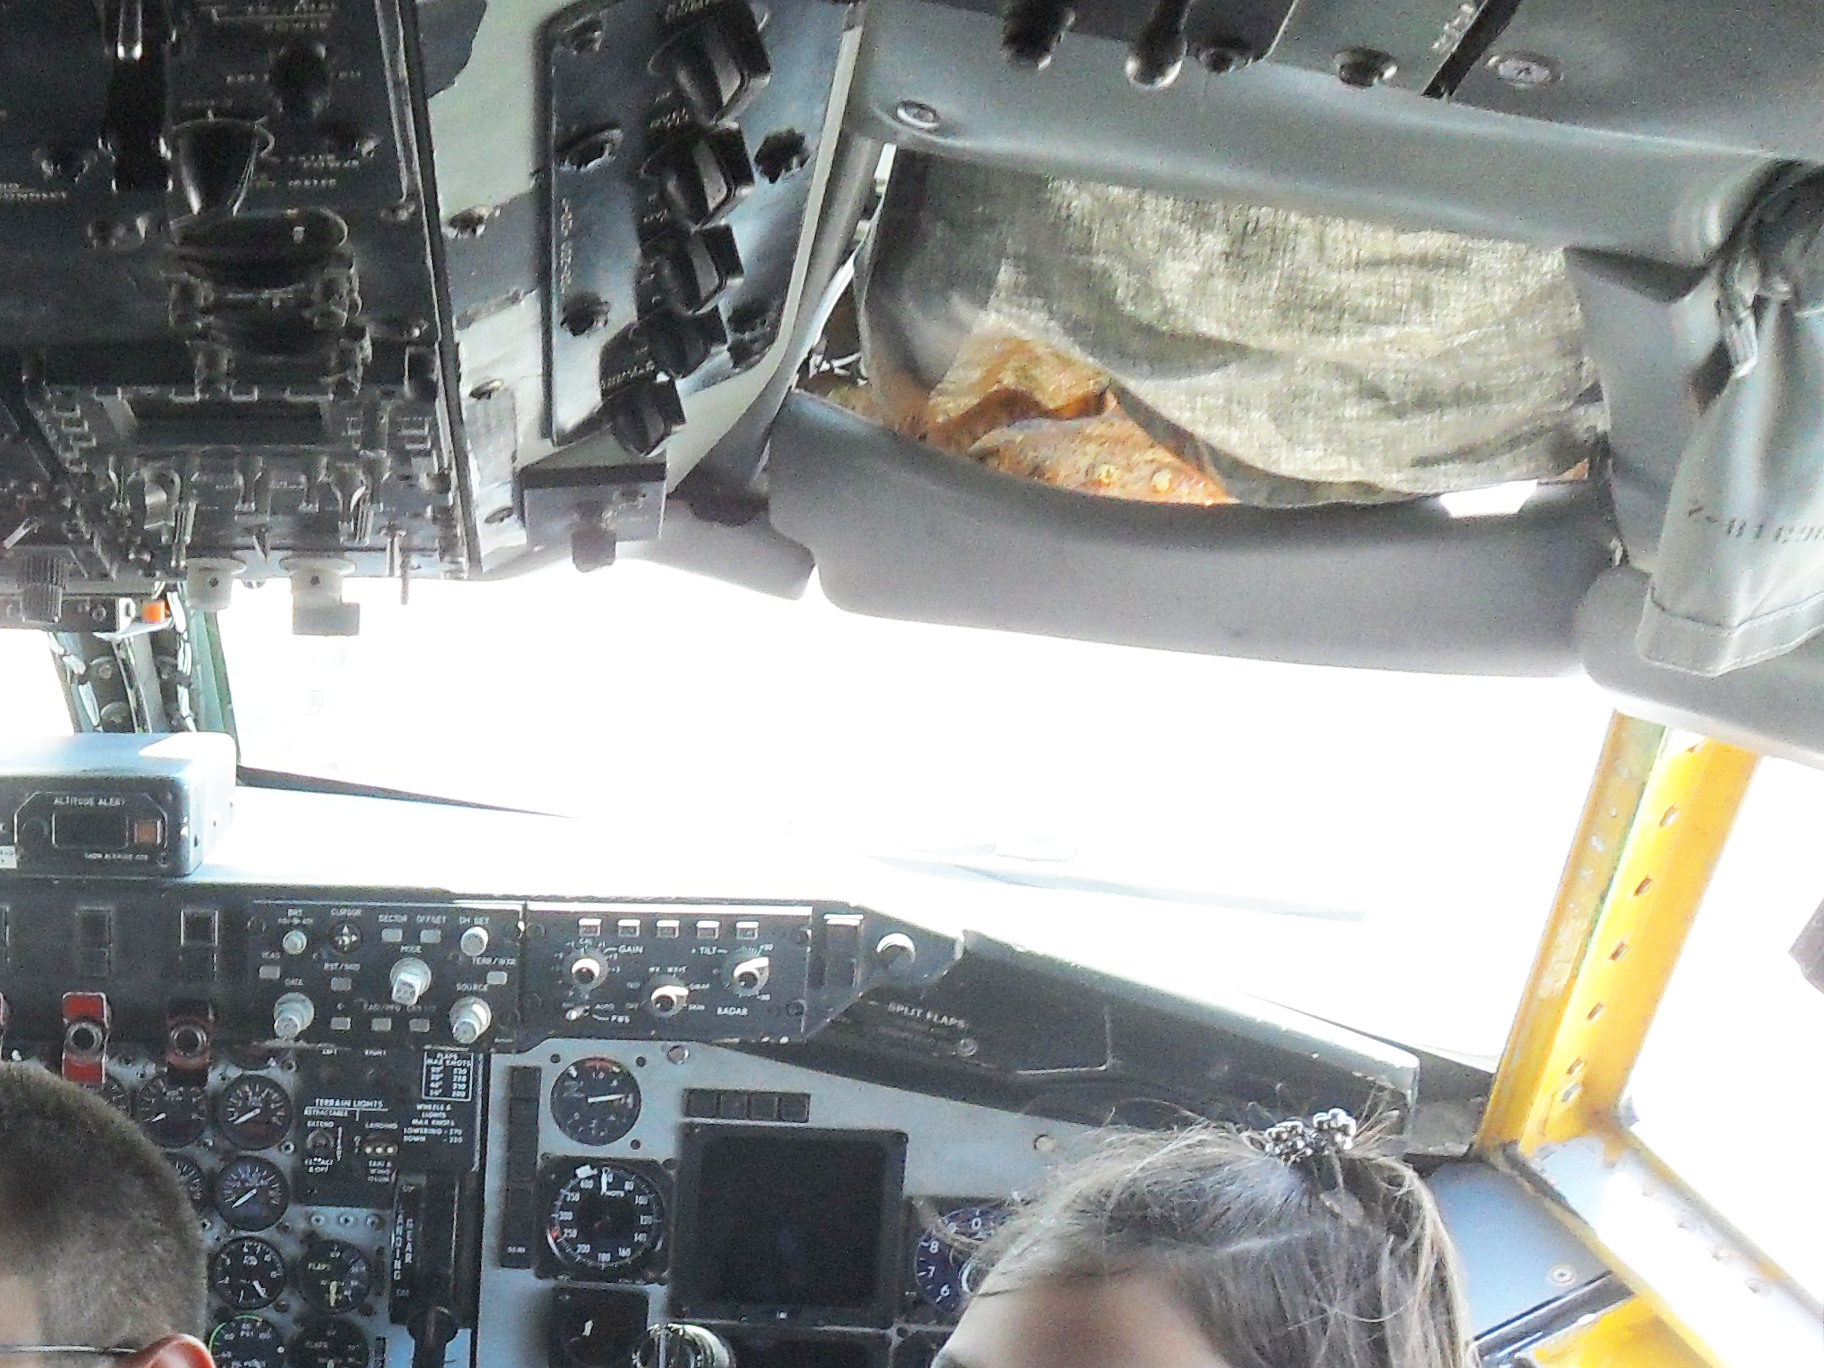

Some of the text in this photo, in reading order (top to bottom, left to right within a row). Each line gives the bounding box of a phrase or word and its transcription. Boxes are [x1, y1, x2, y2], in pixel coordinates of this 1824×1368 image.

[53, 795, 125, 807] ALTITUDE ALERT
[330, 908, 362, 917] CURSOR
[378, 914, 408, 924] SECTOR
[618, 944, 645, 955] GAIN
[699, 945, 718, 956] TILT
[716, 1006, 749, 1016] RADAR
[887, 1001, 968, 1030] SPLIT FLAPS
[315, 1097, 384, 1109] TERRAIN LIGHTS
[403, 1127, 443, 1136] LOWERING
[402, 1135, 427, 1143] DOWN
[971, 1217, 982, 1231] 0
[929, 1240, 940, 1254] 8
[927, 1265, 936, 1278] 7
[940, 1284, 951, 1297] 6
